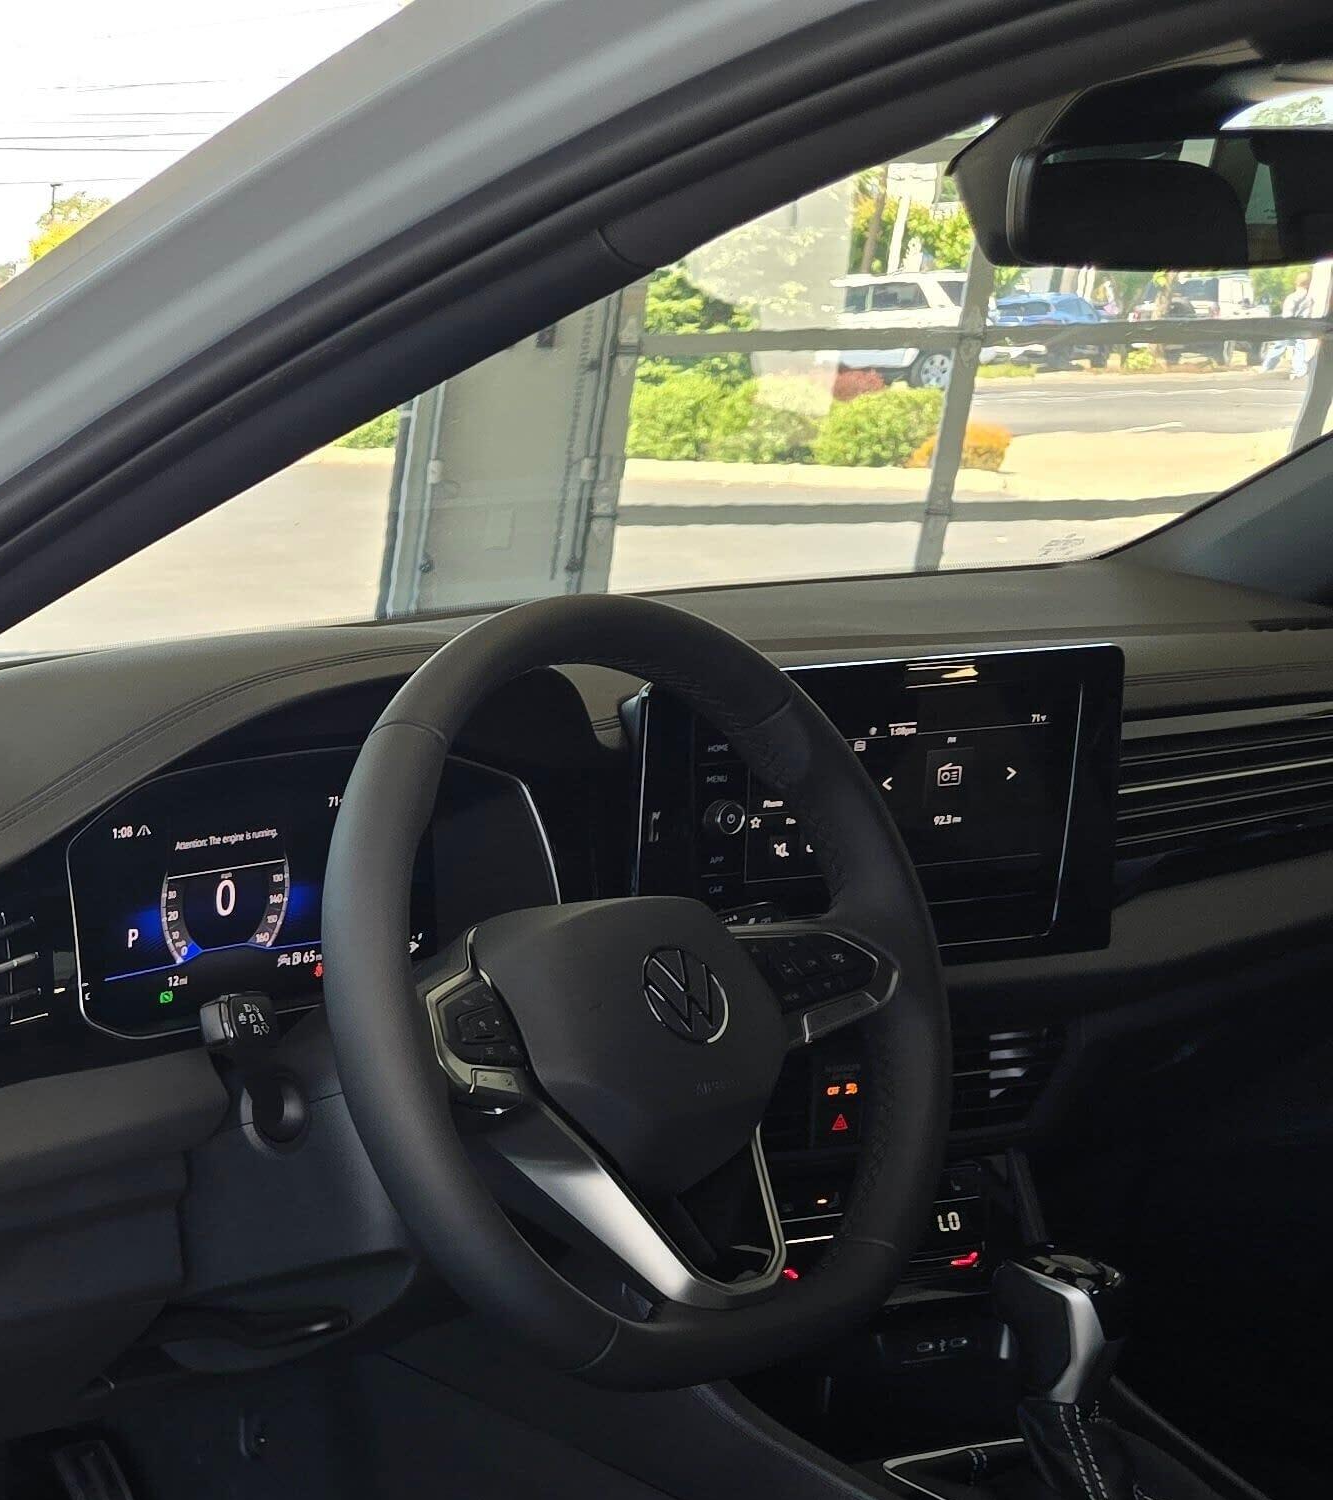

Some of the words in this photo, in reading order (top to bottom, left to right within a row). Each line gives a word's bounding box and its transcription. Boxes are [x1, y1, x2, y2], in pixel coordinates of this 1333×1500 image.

[112, 825, 133, 840] 1:08
[209, 835, 222, 846] The
[222, 832, 244, 845] engine
[245, 830, 252, 840] is
[215, 879, 236, 917] 0
[167, 910, 179, 922] 20
[127, 928, 139, 948] P
[937, 1211, 961, 1232] LO
